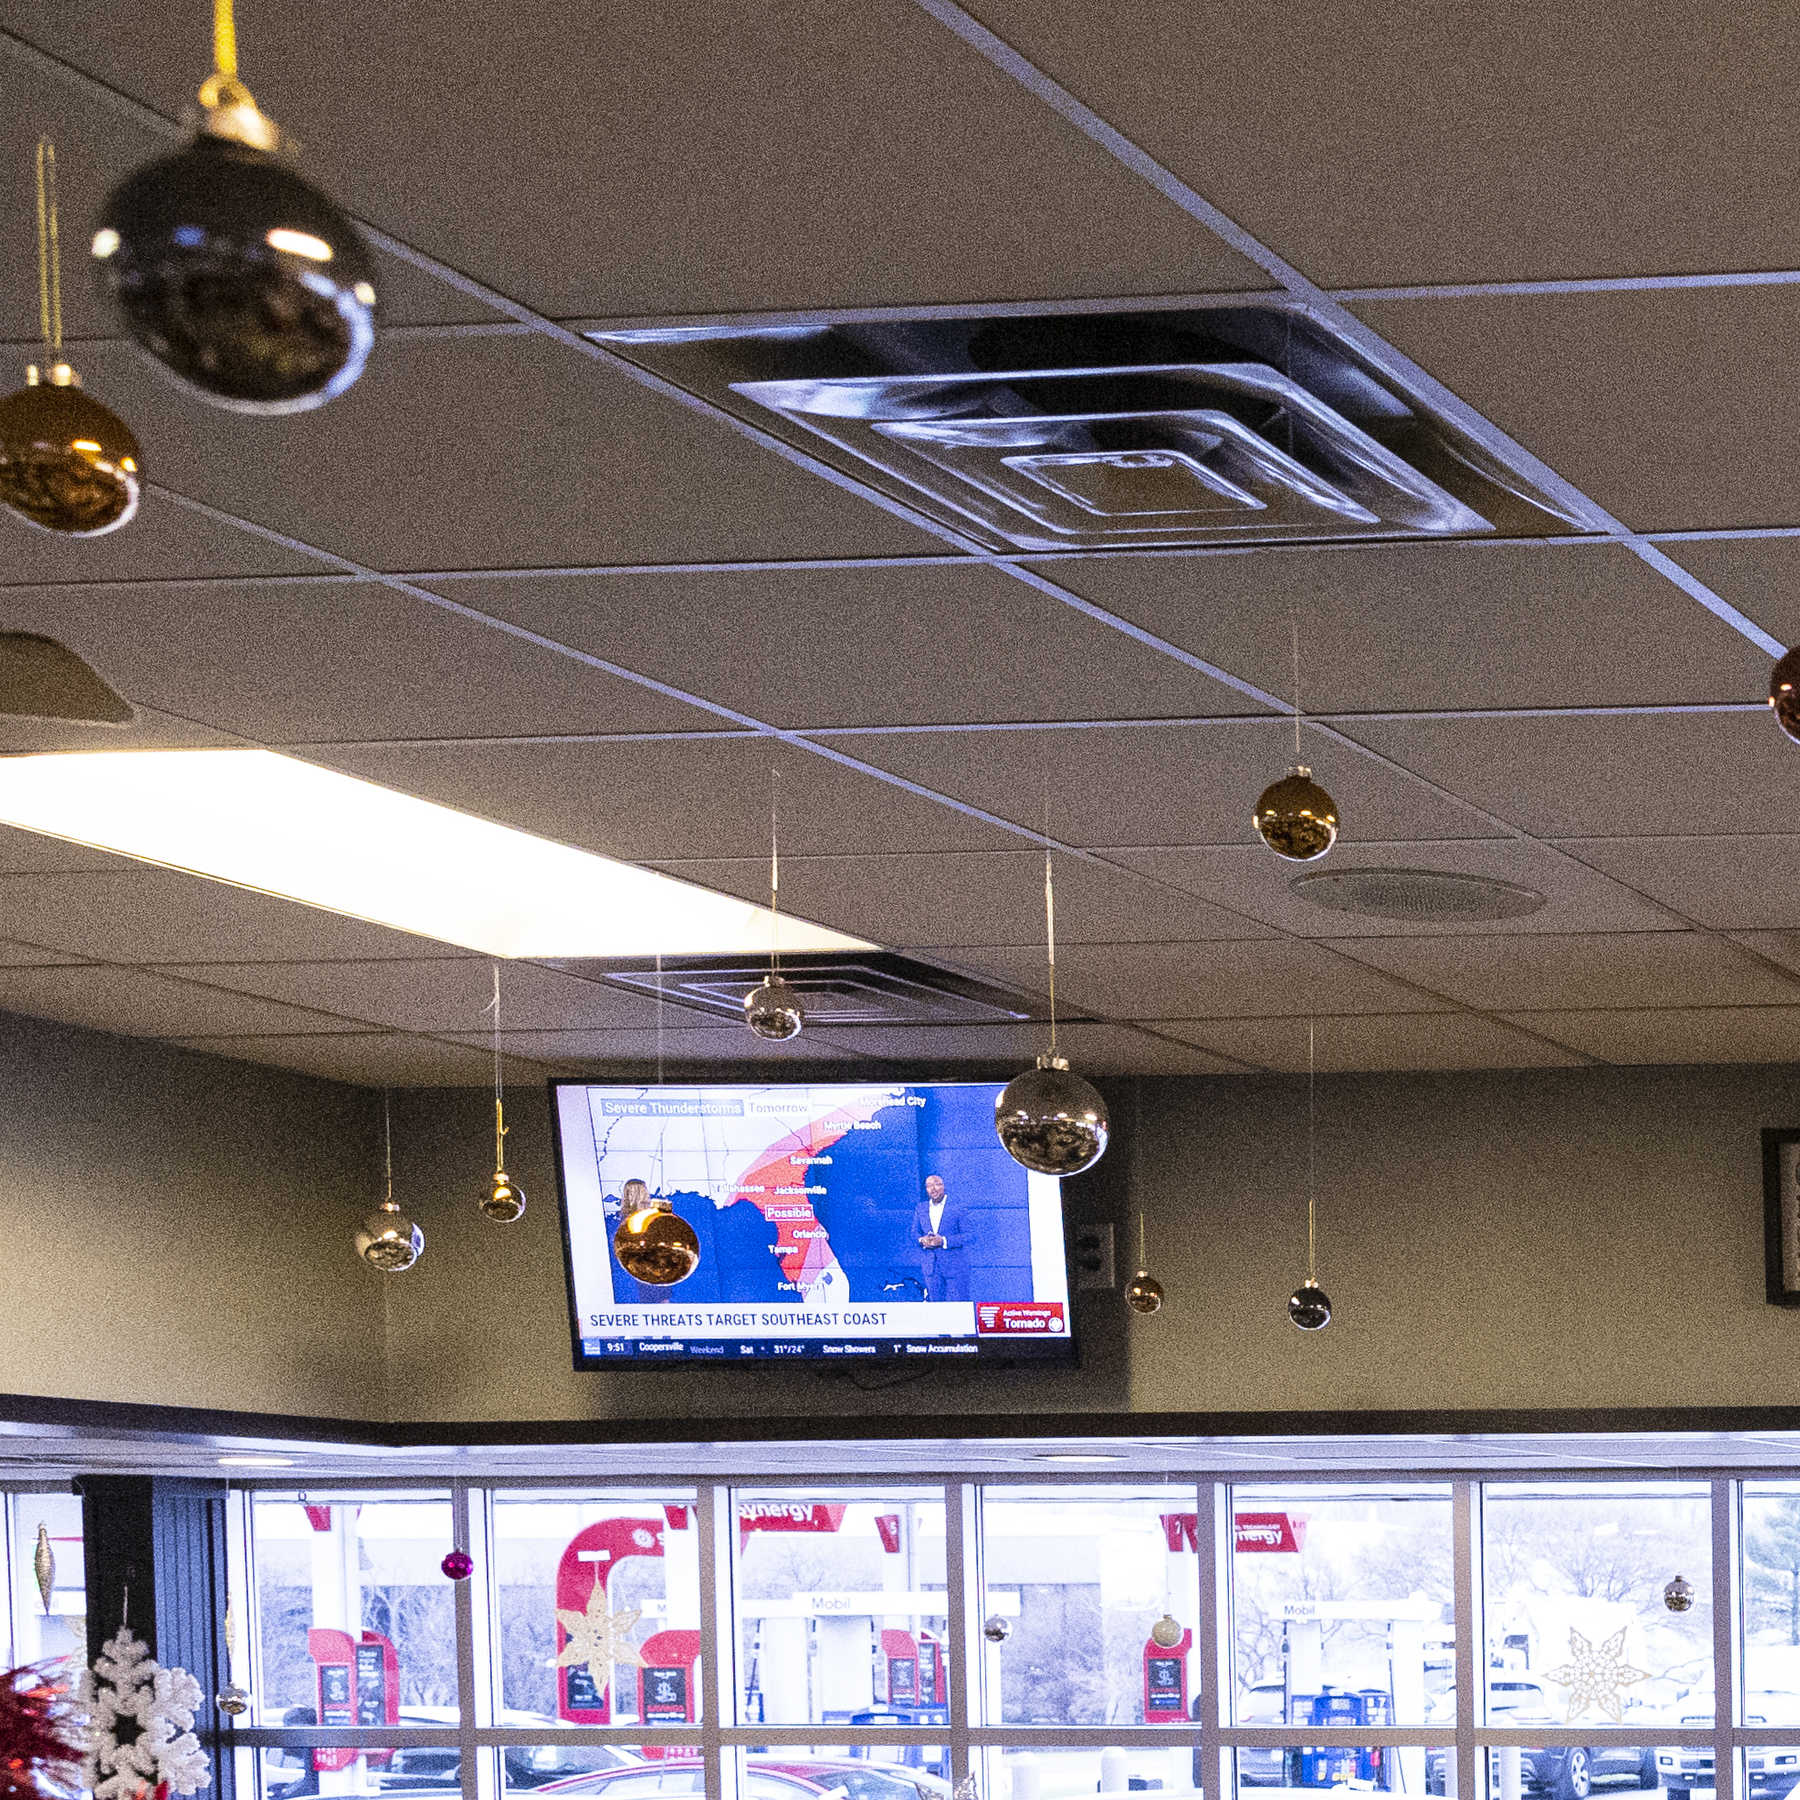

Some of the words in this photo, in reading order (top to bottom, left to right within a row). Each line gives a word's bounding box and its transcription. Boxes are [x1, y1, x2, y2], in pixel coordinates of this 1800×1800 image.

[900, 1096, 926, 1107] City
[605, 1102, 647, 1114] Severe
[651, 1102, 742, 1115] Thunderstorms
[750, 1102, 808, 1114] Tomorrow
[852, 1120, 881, 1130] Beach
[789, 1156, 832, 1165] Savannah
[774, 1186, 827, 1195] Jacksonville
[768, 1207, 811, 1219] Possible
[793, 1230, 826, 1239] Orlando
[768, 1245, 798, 1255] Tampa
[778, 1282, 795, 1290] Fort
[590, 1314, 639, 1327] SEVERE
[642, 1314, 703, 1327] THREATS
[706, 1313, 757, 1326] TARGET
[762, 1313, 838, 1326] SOUTHEAST
[844, 1313, 887, 1326] COAST
[1004, 1318, 1046, 1329] Tornado
[607, 1343, 625, 1352] 9:51
[639, 1342, 684, 1352] Coopersville
[740, 1346, 754, 1354] Sat
[823, 1345, 843, 1354] Snow
[844, 1345, 876, 1354] Showers
[906, 1344, 926, 1353] Snow
[928, 1344, 978, 1353] Accumulation
[1237, 1530, 1283, 1544] nergy
[812, 1598, 850, 1609] Mobil
[1284, 1605, 1315, 1615] Mobil
